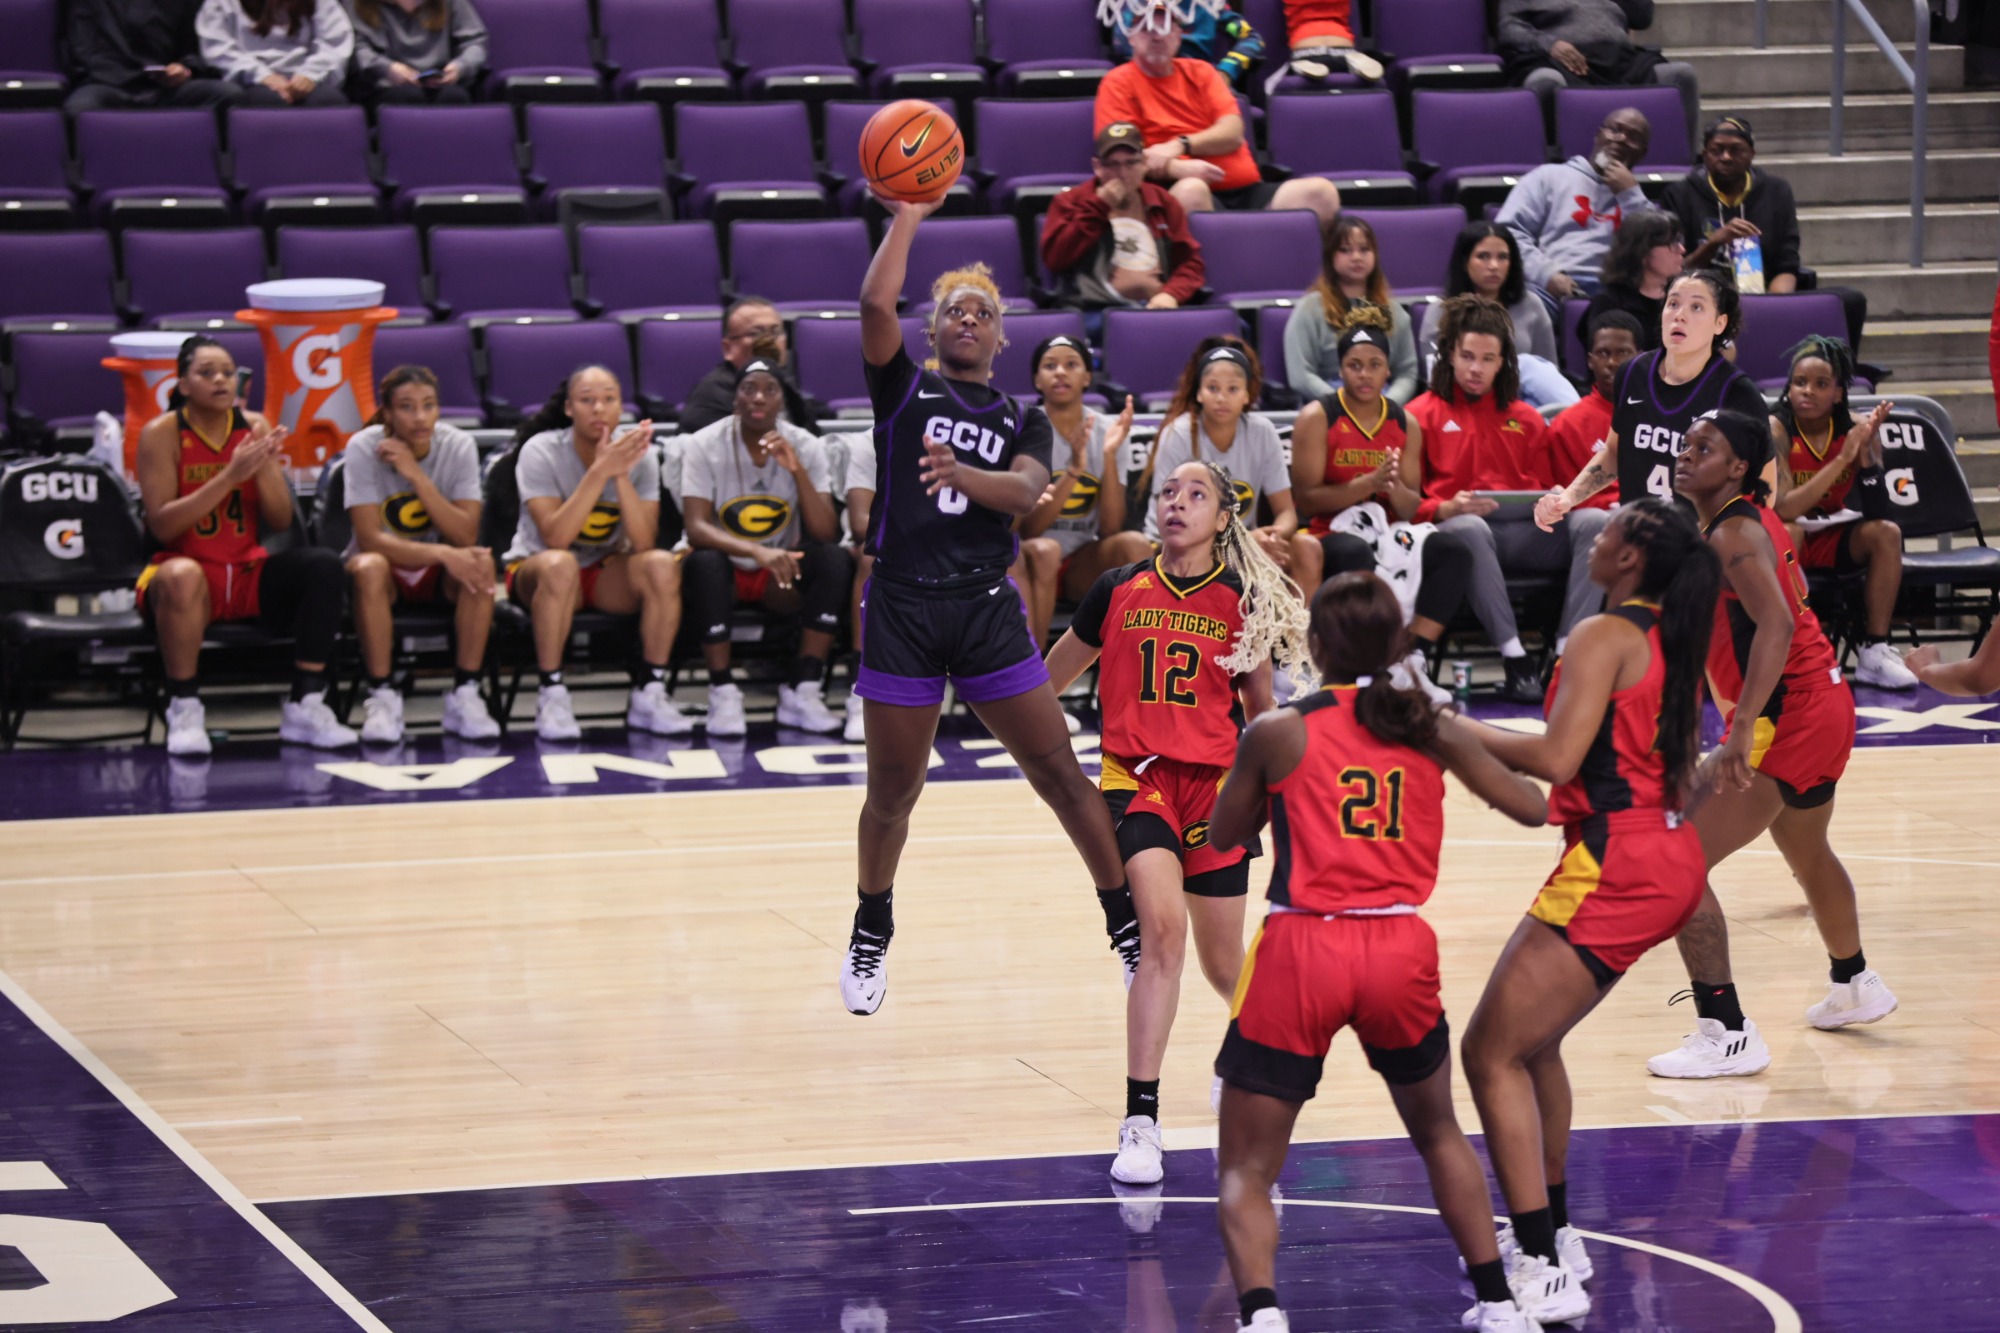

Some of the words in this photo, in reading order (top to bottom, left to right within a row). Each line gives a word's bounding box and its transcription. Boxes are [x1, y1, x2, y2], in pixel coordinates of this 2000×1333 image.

[915, 145, 960, 186] ELITE
[292, 333, 342, 389] G
[925, 415, 1005, 464] GCU
[1879, 422, 1926, 451] CU
[21, 472, 98, 502] GCU
[1646, 464, 1674, 503] 4
[1884, 466, 1920, 506] G
[44, 519, 85, 560] G
[1122, 609, 1166, 631] LADY
[1168, 610, 1228, 642] TIGERS
[1138, 637, 1201, 708] 12
[1337, 765, 1405, 842] 21
